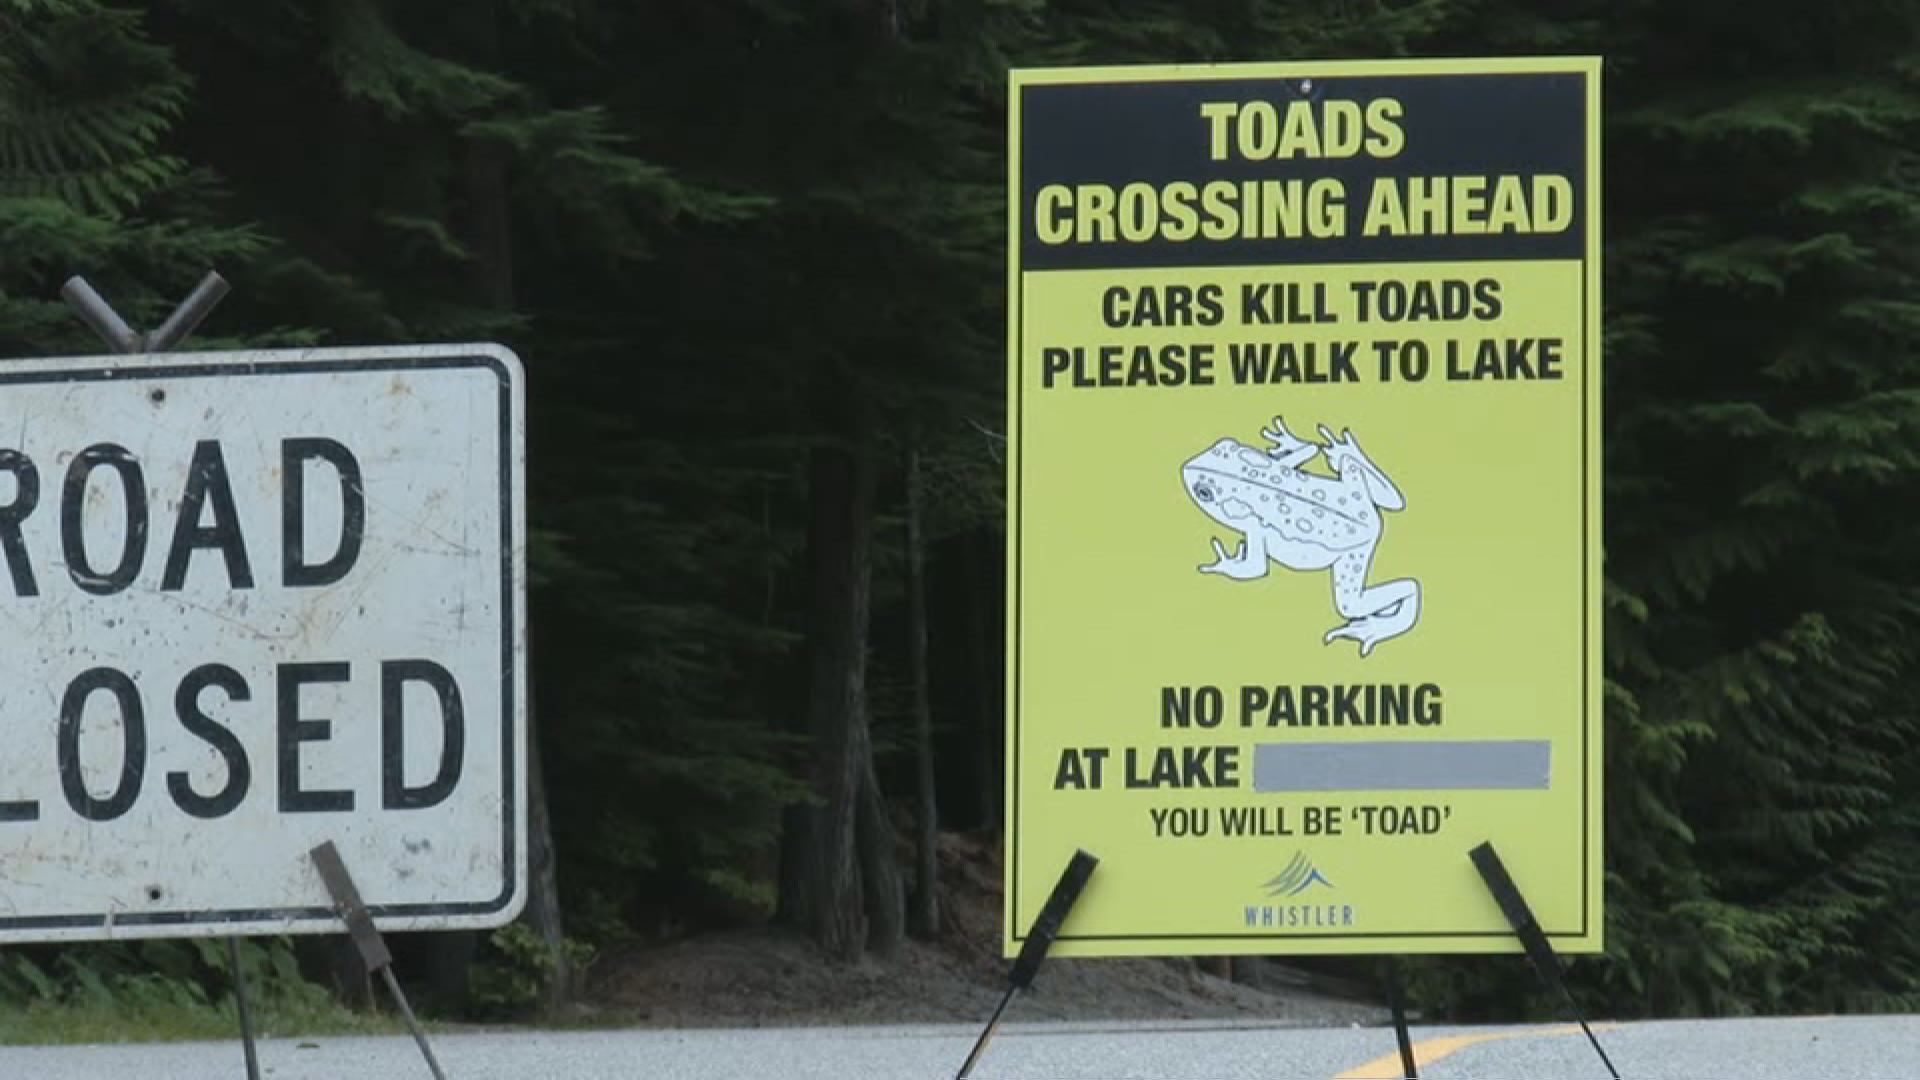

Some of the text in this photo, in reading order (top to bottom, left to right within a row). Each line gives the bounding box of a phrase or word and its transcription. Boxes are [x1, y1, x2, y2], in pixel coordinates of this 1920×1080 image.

[1201, 98, 1405, 161] TOADS
[1035, 174, 1574, 245] CROSSING AHEAD
[1101, 279, 1502, 328] CARS KILL TOADS
[1042, 338, 1563, 388] PLEASE WALK TO LAKE
[1160, 683, 1443, 727] NO PARKING
[1054, 746, 1240, 789] AT LAKE
[1150, 808, 1210, 837] YOU
[1219, 807, 1293, 836] WILL
[1303, 807, 1342, 835] BE
[1244, 905, 1354, 927] WHISTLER
